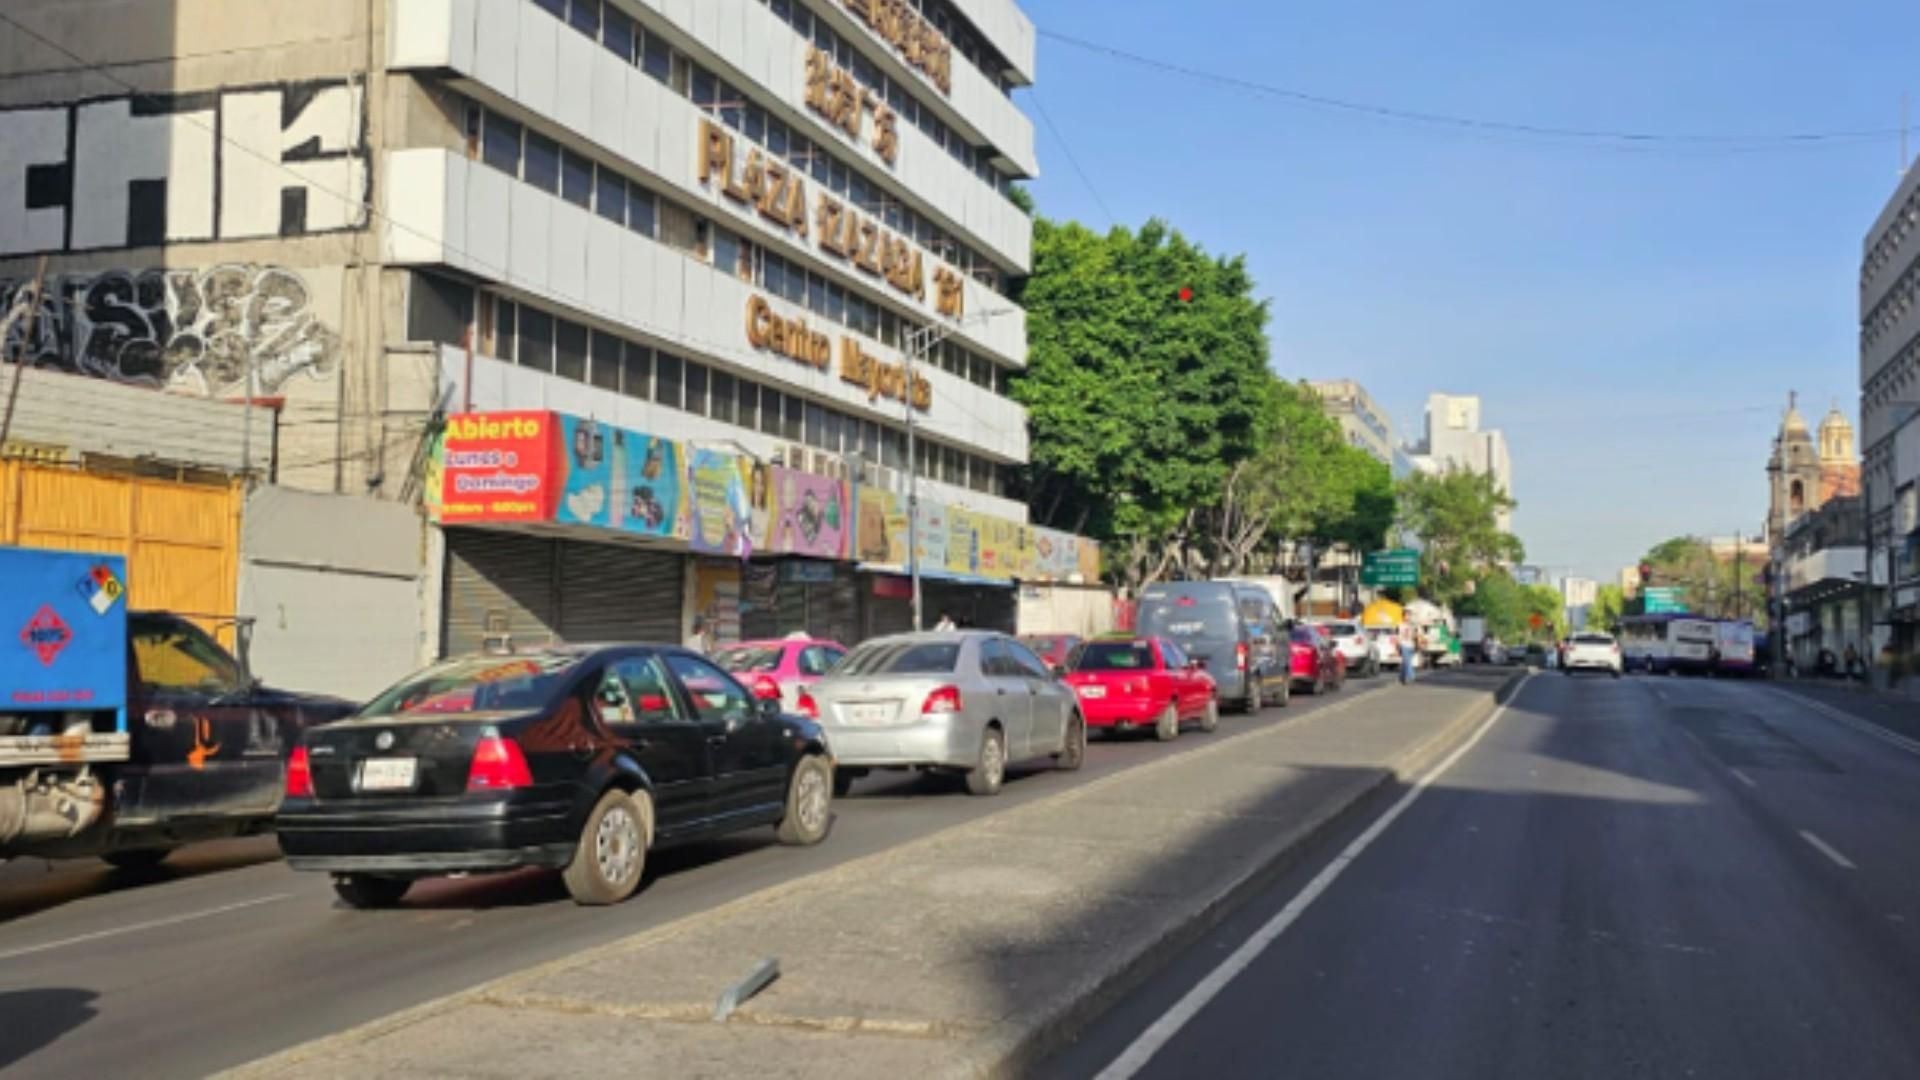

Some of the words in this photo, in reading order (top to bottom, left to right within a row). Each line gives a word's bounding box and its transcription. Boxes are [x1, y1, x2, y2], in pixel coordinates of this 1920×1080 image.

[697, 117, 808, 238] PLAZA
[746, 294, 830, 369] Centro
[446, 416, 539, 440] Abierto
